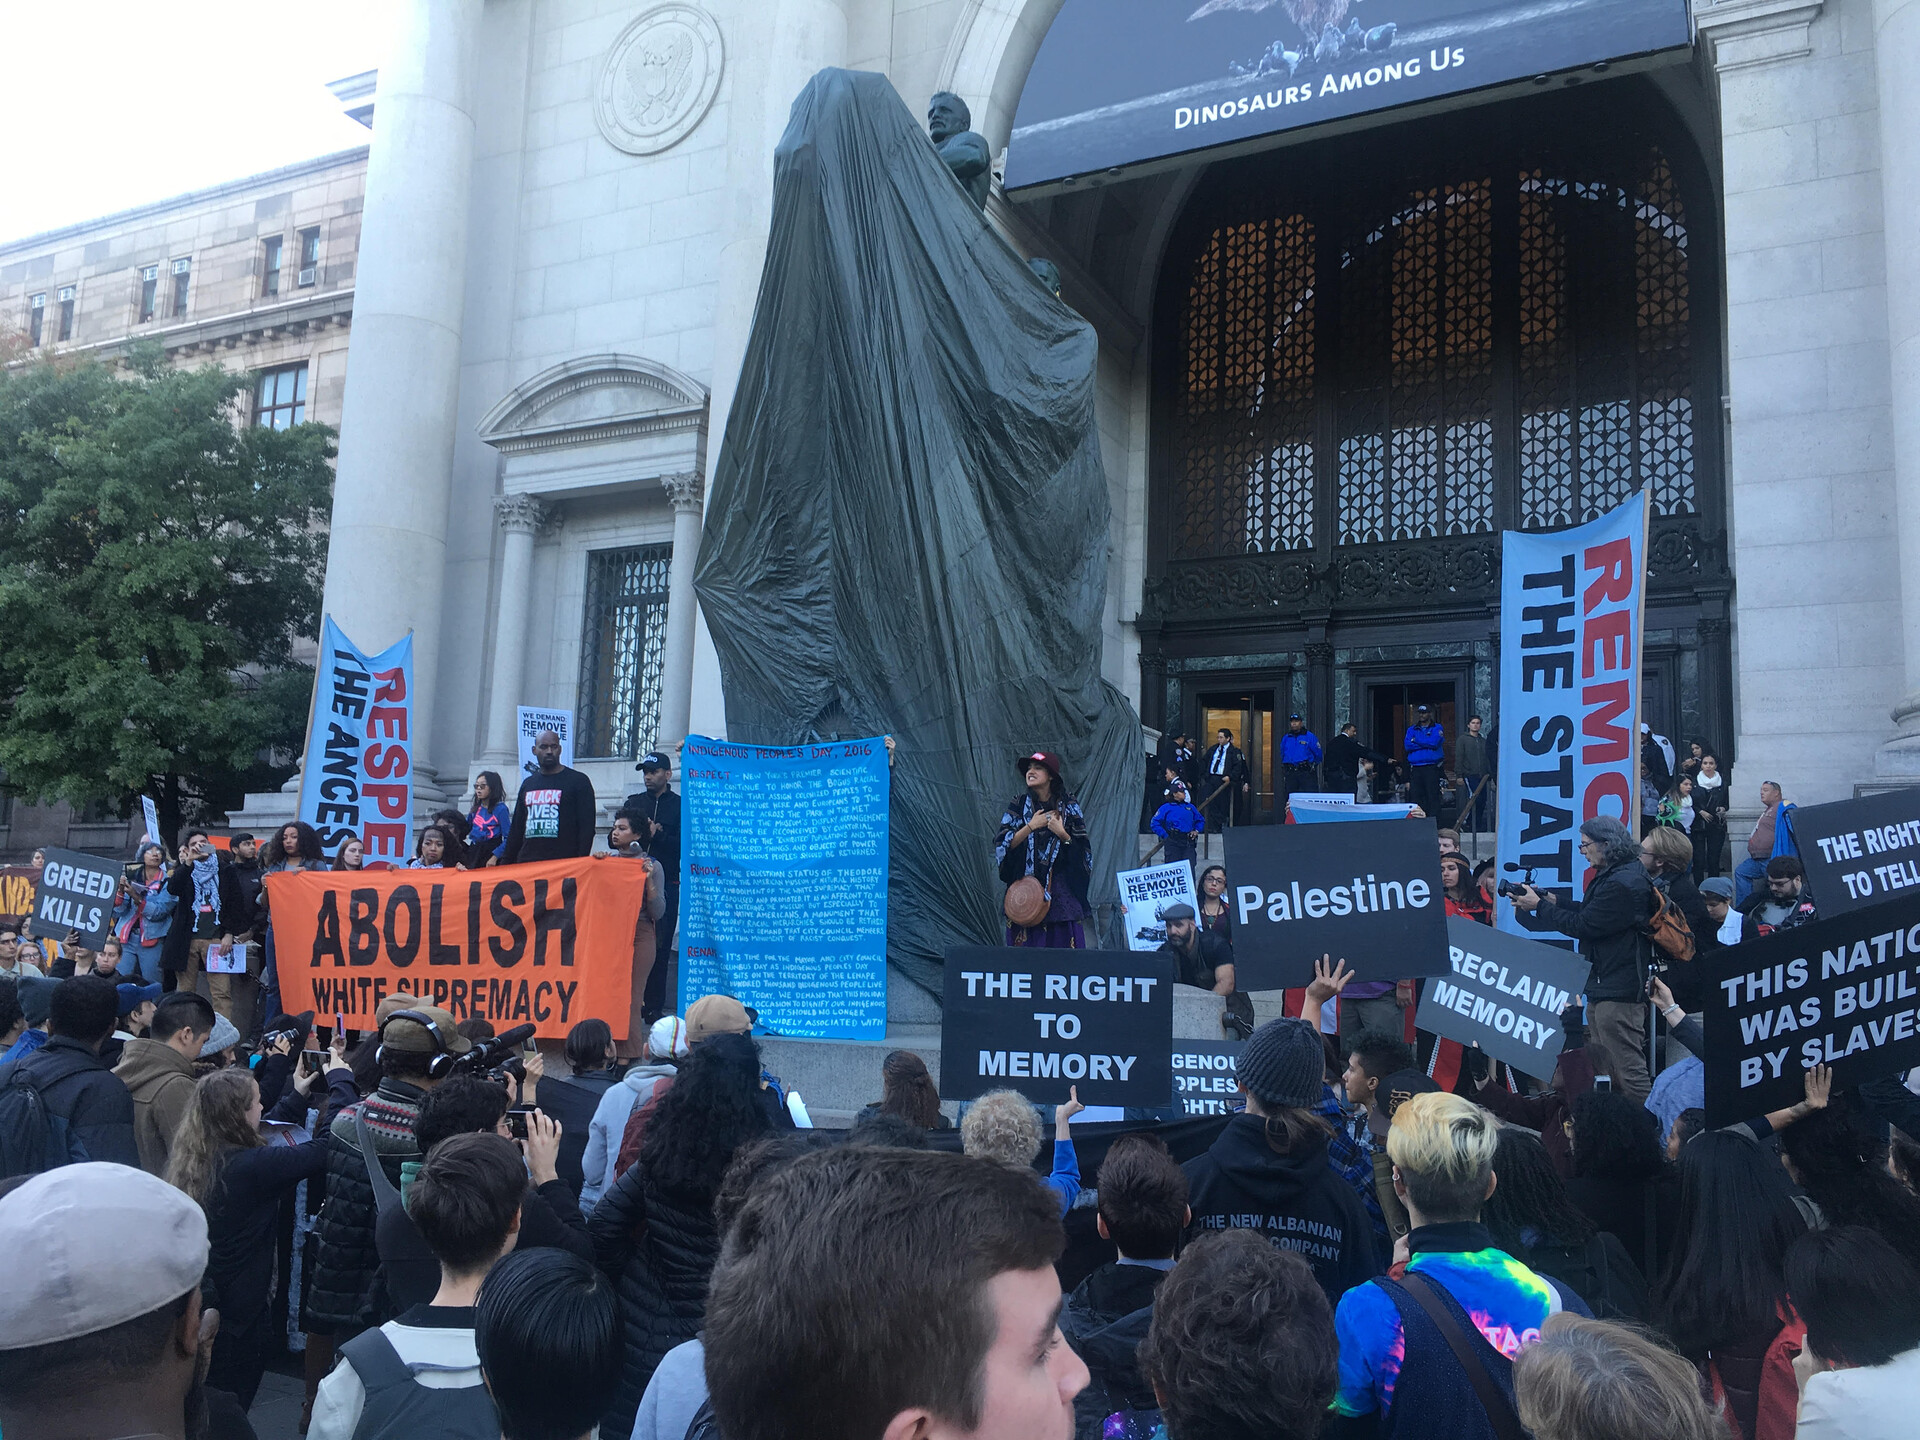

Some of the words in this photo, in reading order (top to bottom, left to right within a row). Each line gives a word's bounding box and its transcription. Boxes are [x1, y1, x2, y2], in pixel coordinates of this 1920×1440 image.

[1521, 555, 1575, 693] THE
[523, 712, 535, 720] WE
[523, 720, 567, 733] REMOVE
[522, 728, 537, 738] THE
[688, 744, 748, 759] INDIGENOUS
[844, 744, 871, 757] 2016
[689, 768, 730, 779] RESPECT
[316, 721, 360, 866] ANCES
[525, 789, 562, 806] BLACK
[1816, 832, 1863, 864] THE
[1863, 820, 1920, 855] RIGHT
[43, 861, 115, 900] GREED
[837, 868, 882, 876] THEODORE
[1125, 876, 1141, 884] WE
[1143, 868, 1185, 880] DEMAND:
[1127, 876, 1186, 895] REMOVE
[1842, 871, 1873, 899] TO
[1874, 860, 1920, 892] TELL
[0, 875, 35, 915] ND:
[1128, 893, 1149, 903] THE
[1151, 885, 1188, 899] STATUE
[1236, 874, 1430, 925] Palestine
[40, 895, 102, 933] KILLS
[310, 877, 577, 968] ABOLISH
[312, 977, 386, 1015] WHITE
[960, 971, 1032, 999] THE
[1044, 974, 1158, 1003] RIGHT
[1449, 945, 1570, 1016] RECLAIM
[1720, 957, 1810, 1009] THIS
[805, 1019, 857, 1027] ASSOCIATED
[1033, 1012, 1082, 1040] TO
[1432, 980, 1556, 1050] MEMORY
[1739, 996, 1821, 1046] WAS
[978, 1050, 1138, 1082] MEMORY
[1740, 1046, 1790, 1090] BY
[1200, 1215, 1226, 1229] THE
[1230, 1214, 1263, 1228] NEW
[1267, 1215, 1342, 1243] ALBANIAN
[1269, 1236, 1340, 1262] COMPANY
